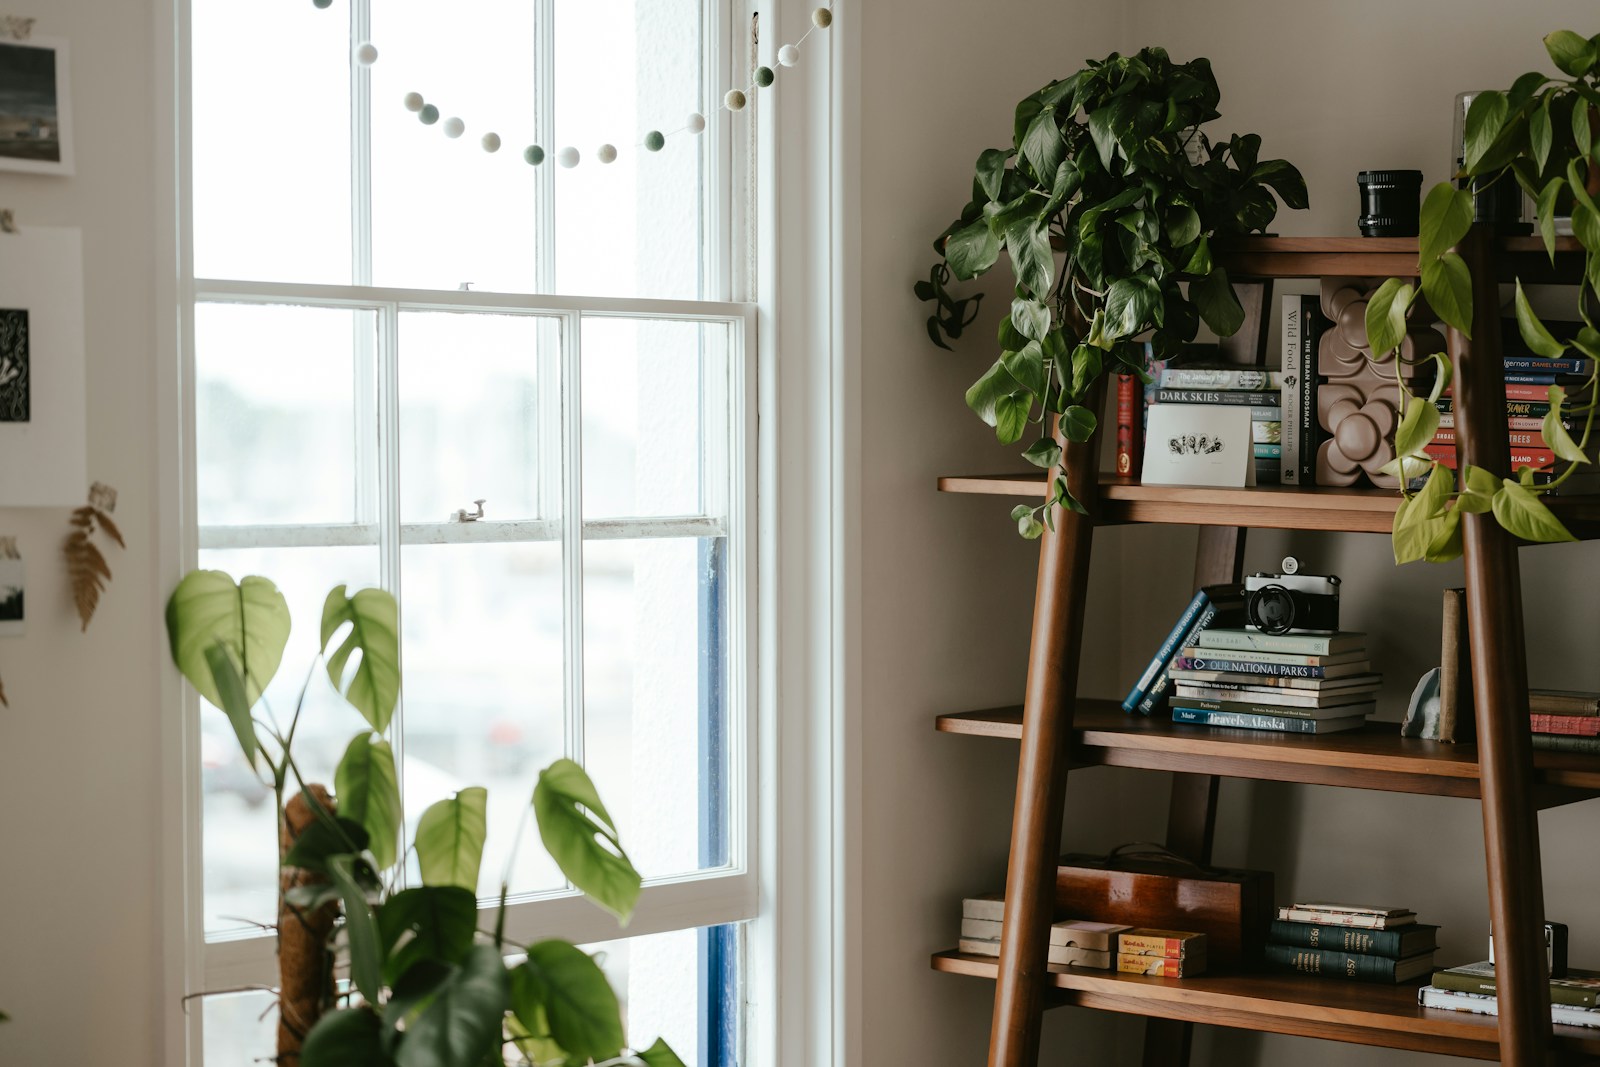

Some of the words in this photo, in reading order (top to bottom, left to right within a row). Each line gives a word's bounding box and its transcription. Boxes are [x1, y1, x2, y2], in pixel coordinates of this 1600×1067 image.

[1287, 310, 1297, 339] Wild
[1286, 343, 1297, 370] Food
[1503, 360, 1530, 369] lgernon
[1179, 372, 1191, 380] The
[1192, 372, 1215, 383] January
[1160, 391, 1189, 401] DARK
[1190, 392, 1220, 403] SKIES
[1509, 434, 1531, 443] TREES
[1510, 455, 1532, 463] RLAND
[1191, 600, 1202, 613] for
[1182, 613, 1193, 626] one
[1202, 610, 1214, 628] CALM
[1169, 625, 1184, 645] more
[1160, 644, 1172, 658] day
[1210, 660, 1231, 670] OUR
[1231, 662, 1279, 675] NATIONAL
[1280, 666, 1308, 677] PARKS
[1181, 711, 1196, 720] Muir
[1208, 713, 1245, 726] Travels
[1247, 716, 1285, 730] Alaska
[1123, 940, 1145, 948] Kodak
[1346, 958, 1356, 977] 1957
